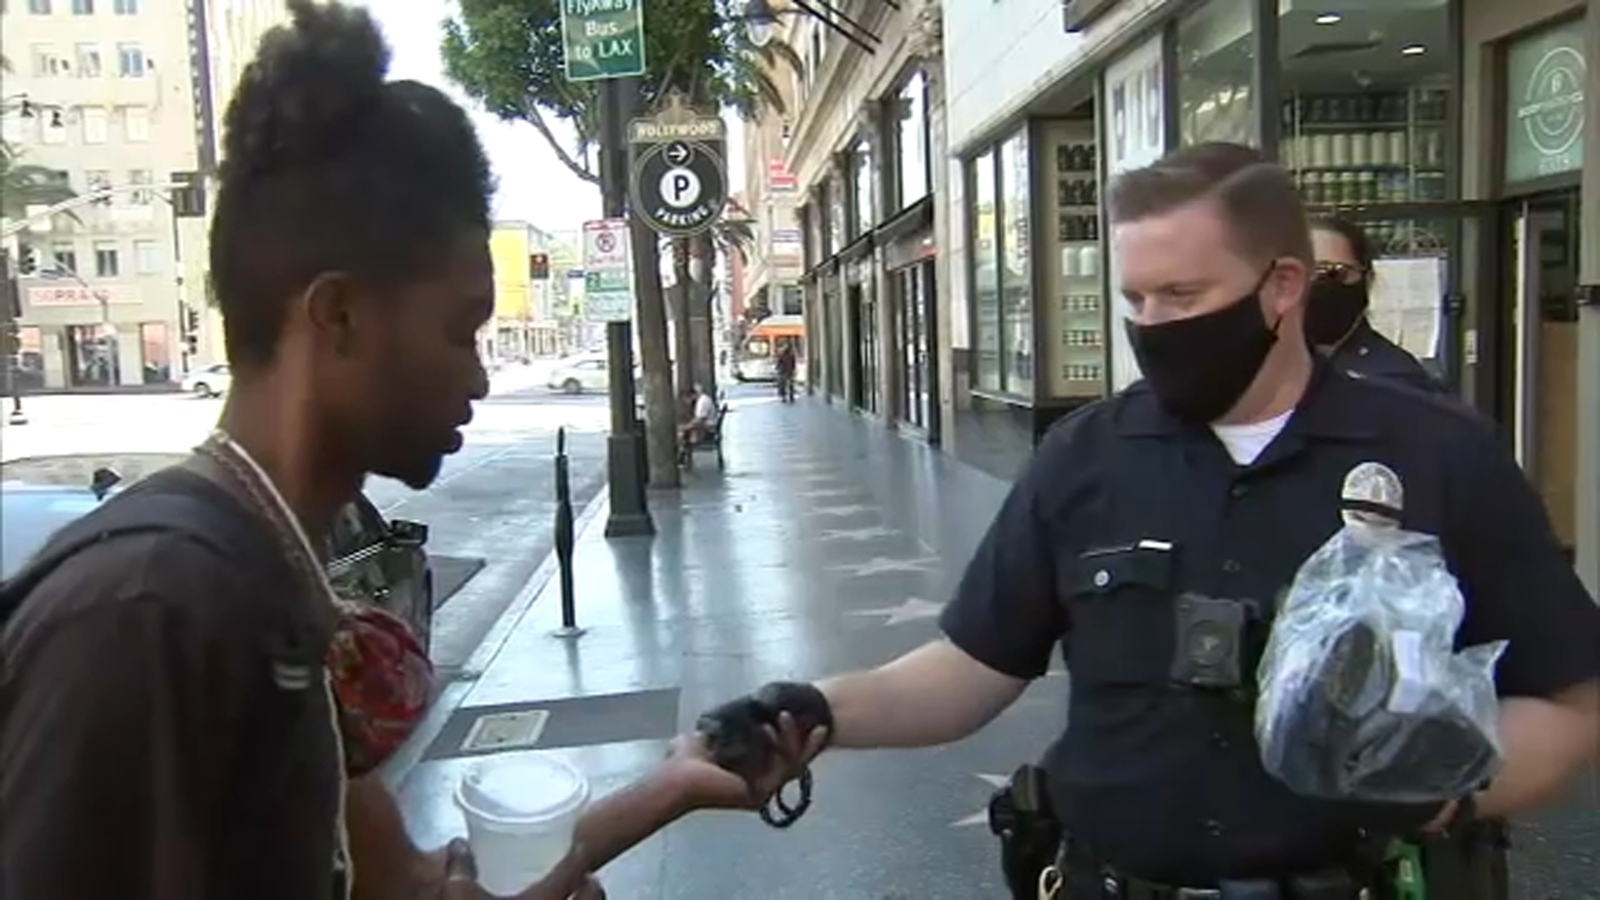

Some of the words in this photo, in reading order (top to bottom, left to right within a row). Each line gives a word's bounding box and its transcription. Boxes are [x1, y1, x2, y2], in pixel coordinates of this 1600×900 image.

[567, 0, 633, 15] FlyAway
[585, 21, 618, 36] Bus
[575, 46, 591, 60] to
[599, 40, 632, 57] LAX
[637, 121, 717, 137] HOLLYWOOD
[673, 174, 690, 201] P
[655, 204, 708, 226] PARKING
